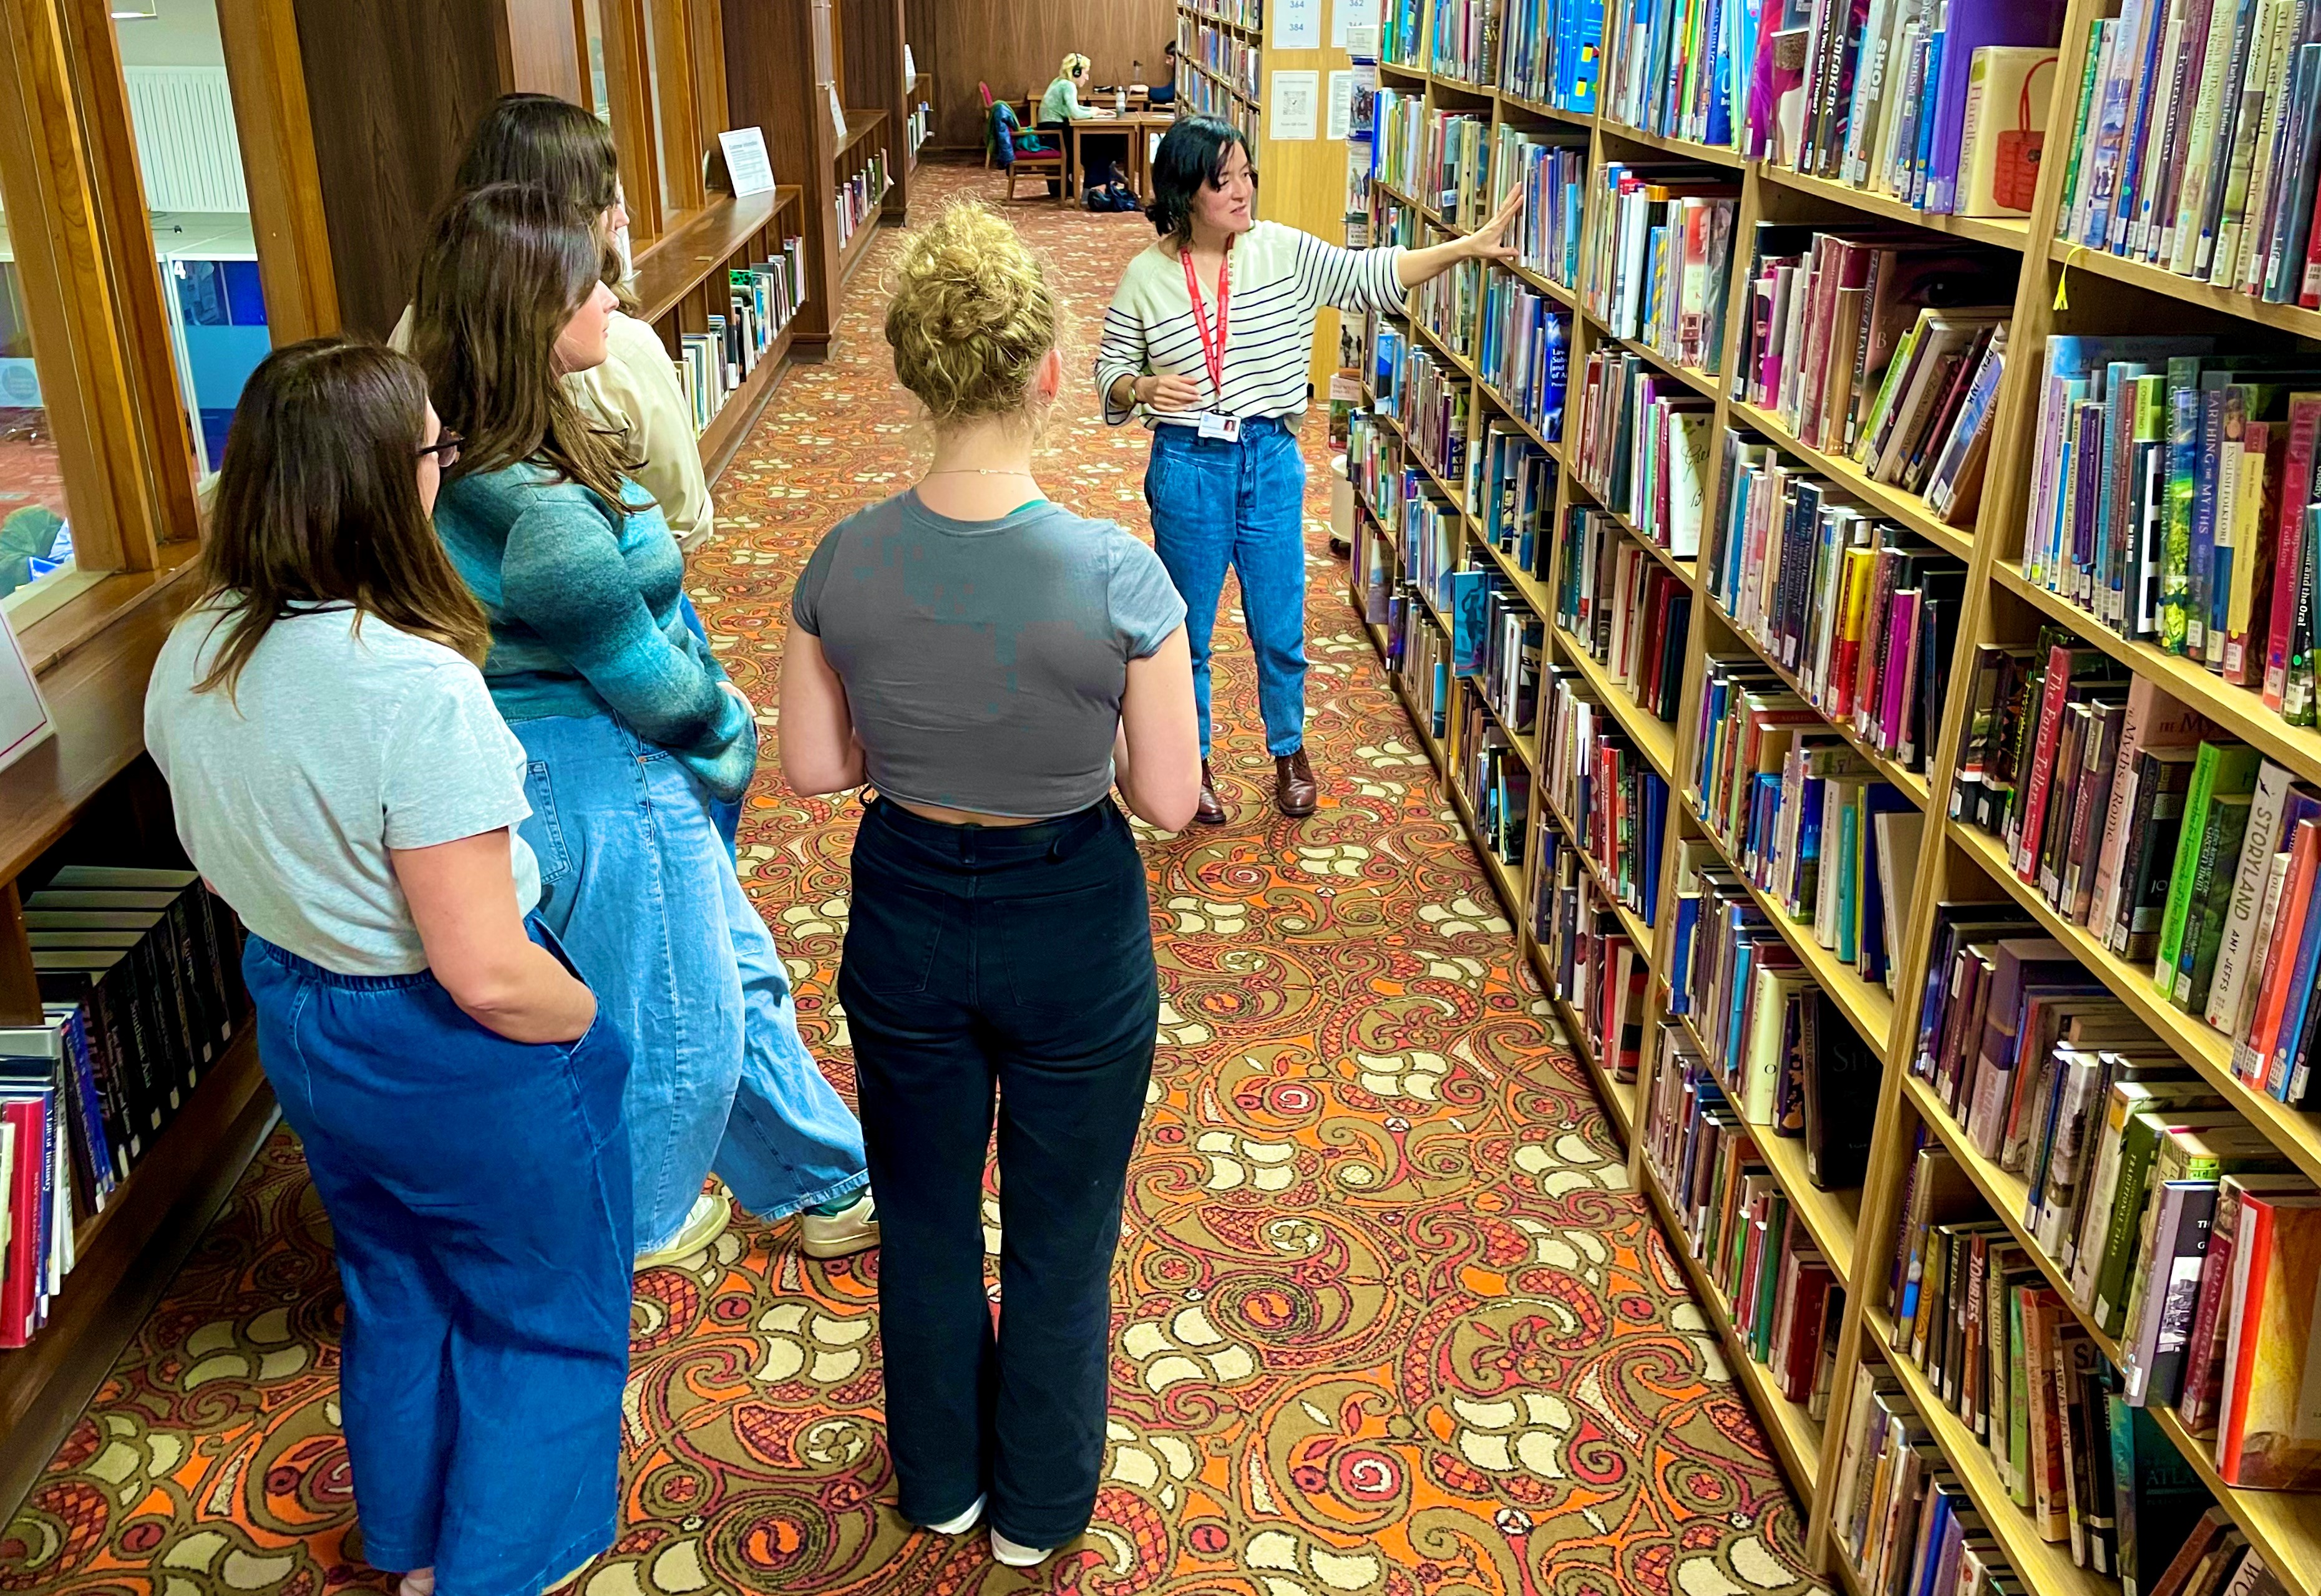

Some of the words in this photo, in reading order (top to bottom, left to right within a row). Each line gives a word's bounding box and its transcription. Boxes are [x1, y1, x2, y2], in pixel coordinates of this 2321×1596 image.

[1820, 33, 1829, 52] You
[2234, 39, 2243, 54] Duel
[2237, 25, 2246, 37] The
[1816, 54, 1826, 74] Get
[1869, 38, 1887, 100] SHOE
[2228, 64, 2239, 81] Early
[1812, 76, 1823, 114] Those?
[1849, 79, 1867, 150] SHOES
[2163, 51, 2189, 162] Tournament
[2202, 75, 2220, 129] Medieval
[2224, 83, 2236, 107] Modern
[1960, 87, 1983, 173] Handbags
[2219, 109, 2231, 135] England
[1853, 325, 1869, 377] BEAUTY
[1977, 348, 1995, 372] PEN
[1966, 382, 1982, 406] INK
[2071, 420, 2080, 455] WEDDING
[2204, 390, 2221, 463] EARTHING
[2068, 458, 2077, 495] SPEECHES
[2224, 446, 2236, 488] ENGLISH
[2198, 484, 2212, 534] MYTHS
[2219, 491, 2232, 543] FOLKLORE
[2280, 525, 2293, 568] Folklore
[2288, 515, 2303, 578] Companion
[2297, 605, 2308, 626] Oral
[2300, 587, 2310, 604] the
[2047, 674, 2063, 699] The
[2037, 708, 2056, 748] Fairy
[2116, 724, 2136, 778] Myths
[2029, 757, 2048, 805] Tellers
[2105, 792, 2124, 842] Rome
[2234, 809, 2274, 921] STORYLAND
[2268, 877, 2279, 897] OUT
[2227, 928, 2241, 954] AMY
[2219, 958, 2236, 991] JEFFS
[129, 999, 146, 1060] Southeast
[139, 1061, 152, 1089] Asia
[46, 1138, 52, 1147] of
[42, 1151, 52, 1192] Industry
[2118, 1154, 2137, 1222] TRADITIONAL
[2110, 1227, 2122, 1257] TALES
[1967, 1253, 1983, 1323] ZOMBIES
[1993, 1306, 2002, 1348] HOOD
[2055, 1359, 2068, 1410] SAWNEY
[2060, 1414, 2071, 1448] BEAN
